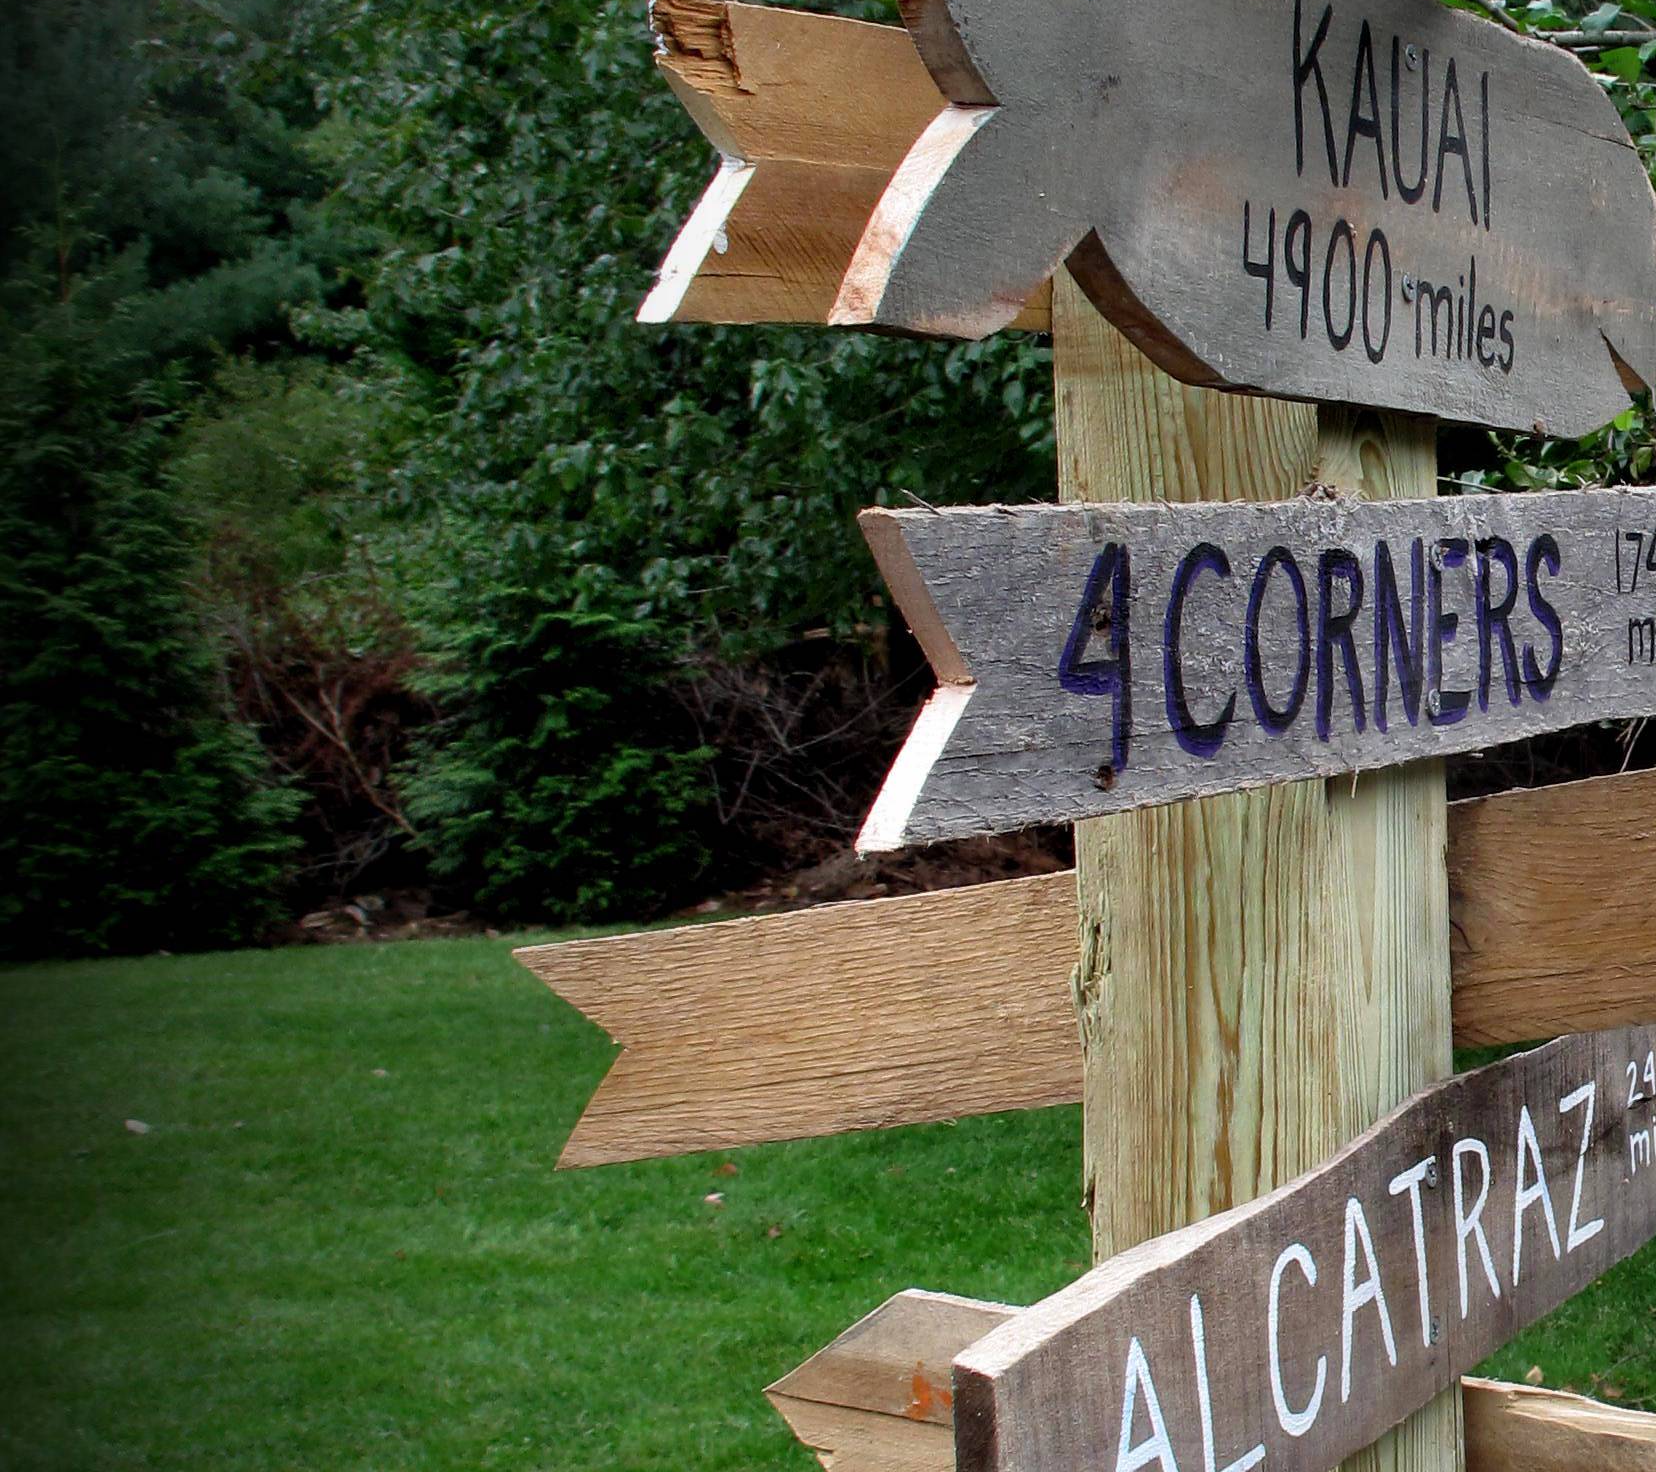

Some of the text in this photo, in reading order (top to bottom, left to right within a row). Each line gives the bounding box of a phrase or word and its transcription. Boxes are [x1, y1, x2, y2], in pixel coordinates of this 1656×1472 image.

[1243, 199, 1515, 374] 4900 miles
[1057, 532, 1565, 775] 4 CORNERS
